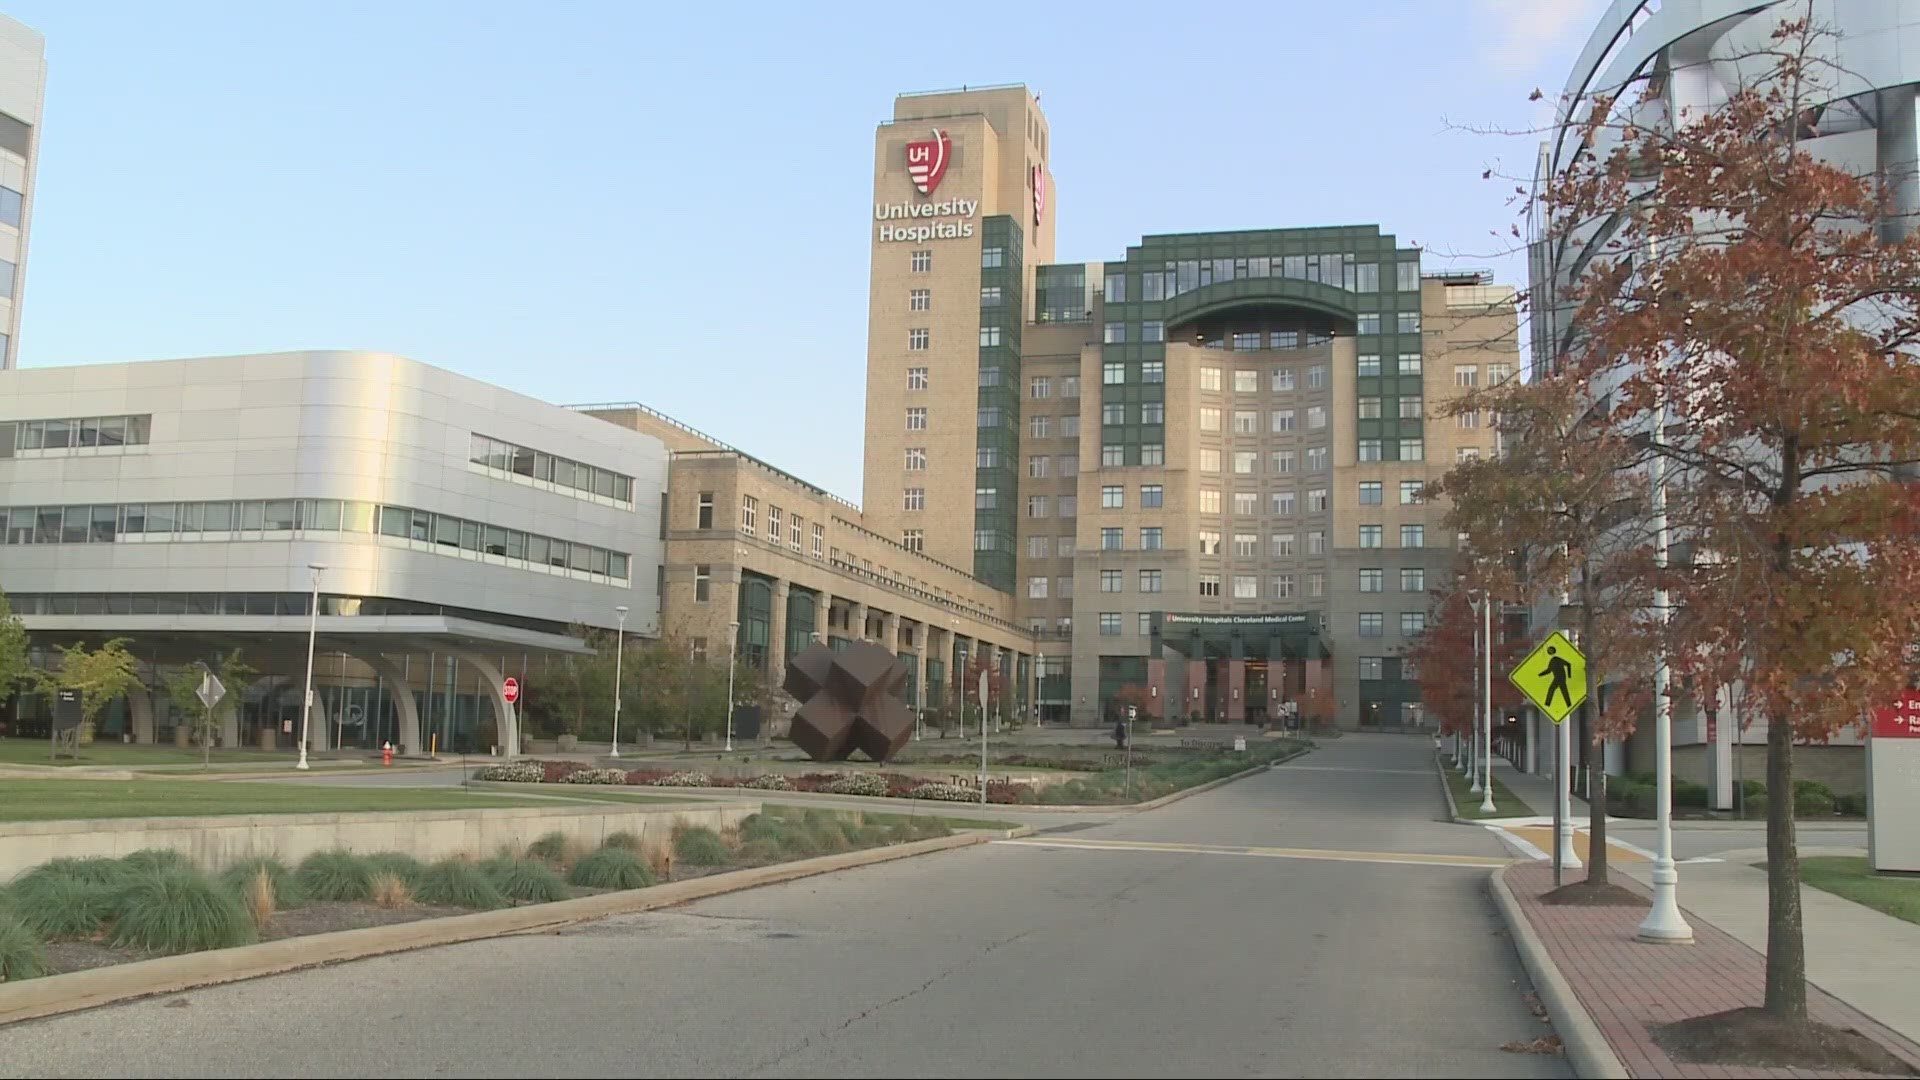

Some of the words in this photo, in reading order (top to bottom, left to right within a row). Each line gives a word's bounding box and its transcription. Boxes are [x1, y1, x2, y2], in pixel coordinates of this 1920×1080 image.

[909, 146, 929, 162] UH
[875, 197, 978, 221] University
[879, 220, 973, 244] Hospitals
[1171, 614, 1202, 624] University
[1203, 615, 1232, 624] Hospitals
[1233, 615, 1264, 624] Cleveland
[1265, 615, 1287, 623] Medical
[1288, 614, 1306, 622] Center
[505, 685, 517, 696] STOP
[950, 774, 968, 787] To
